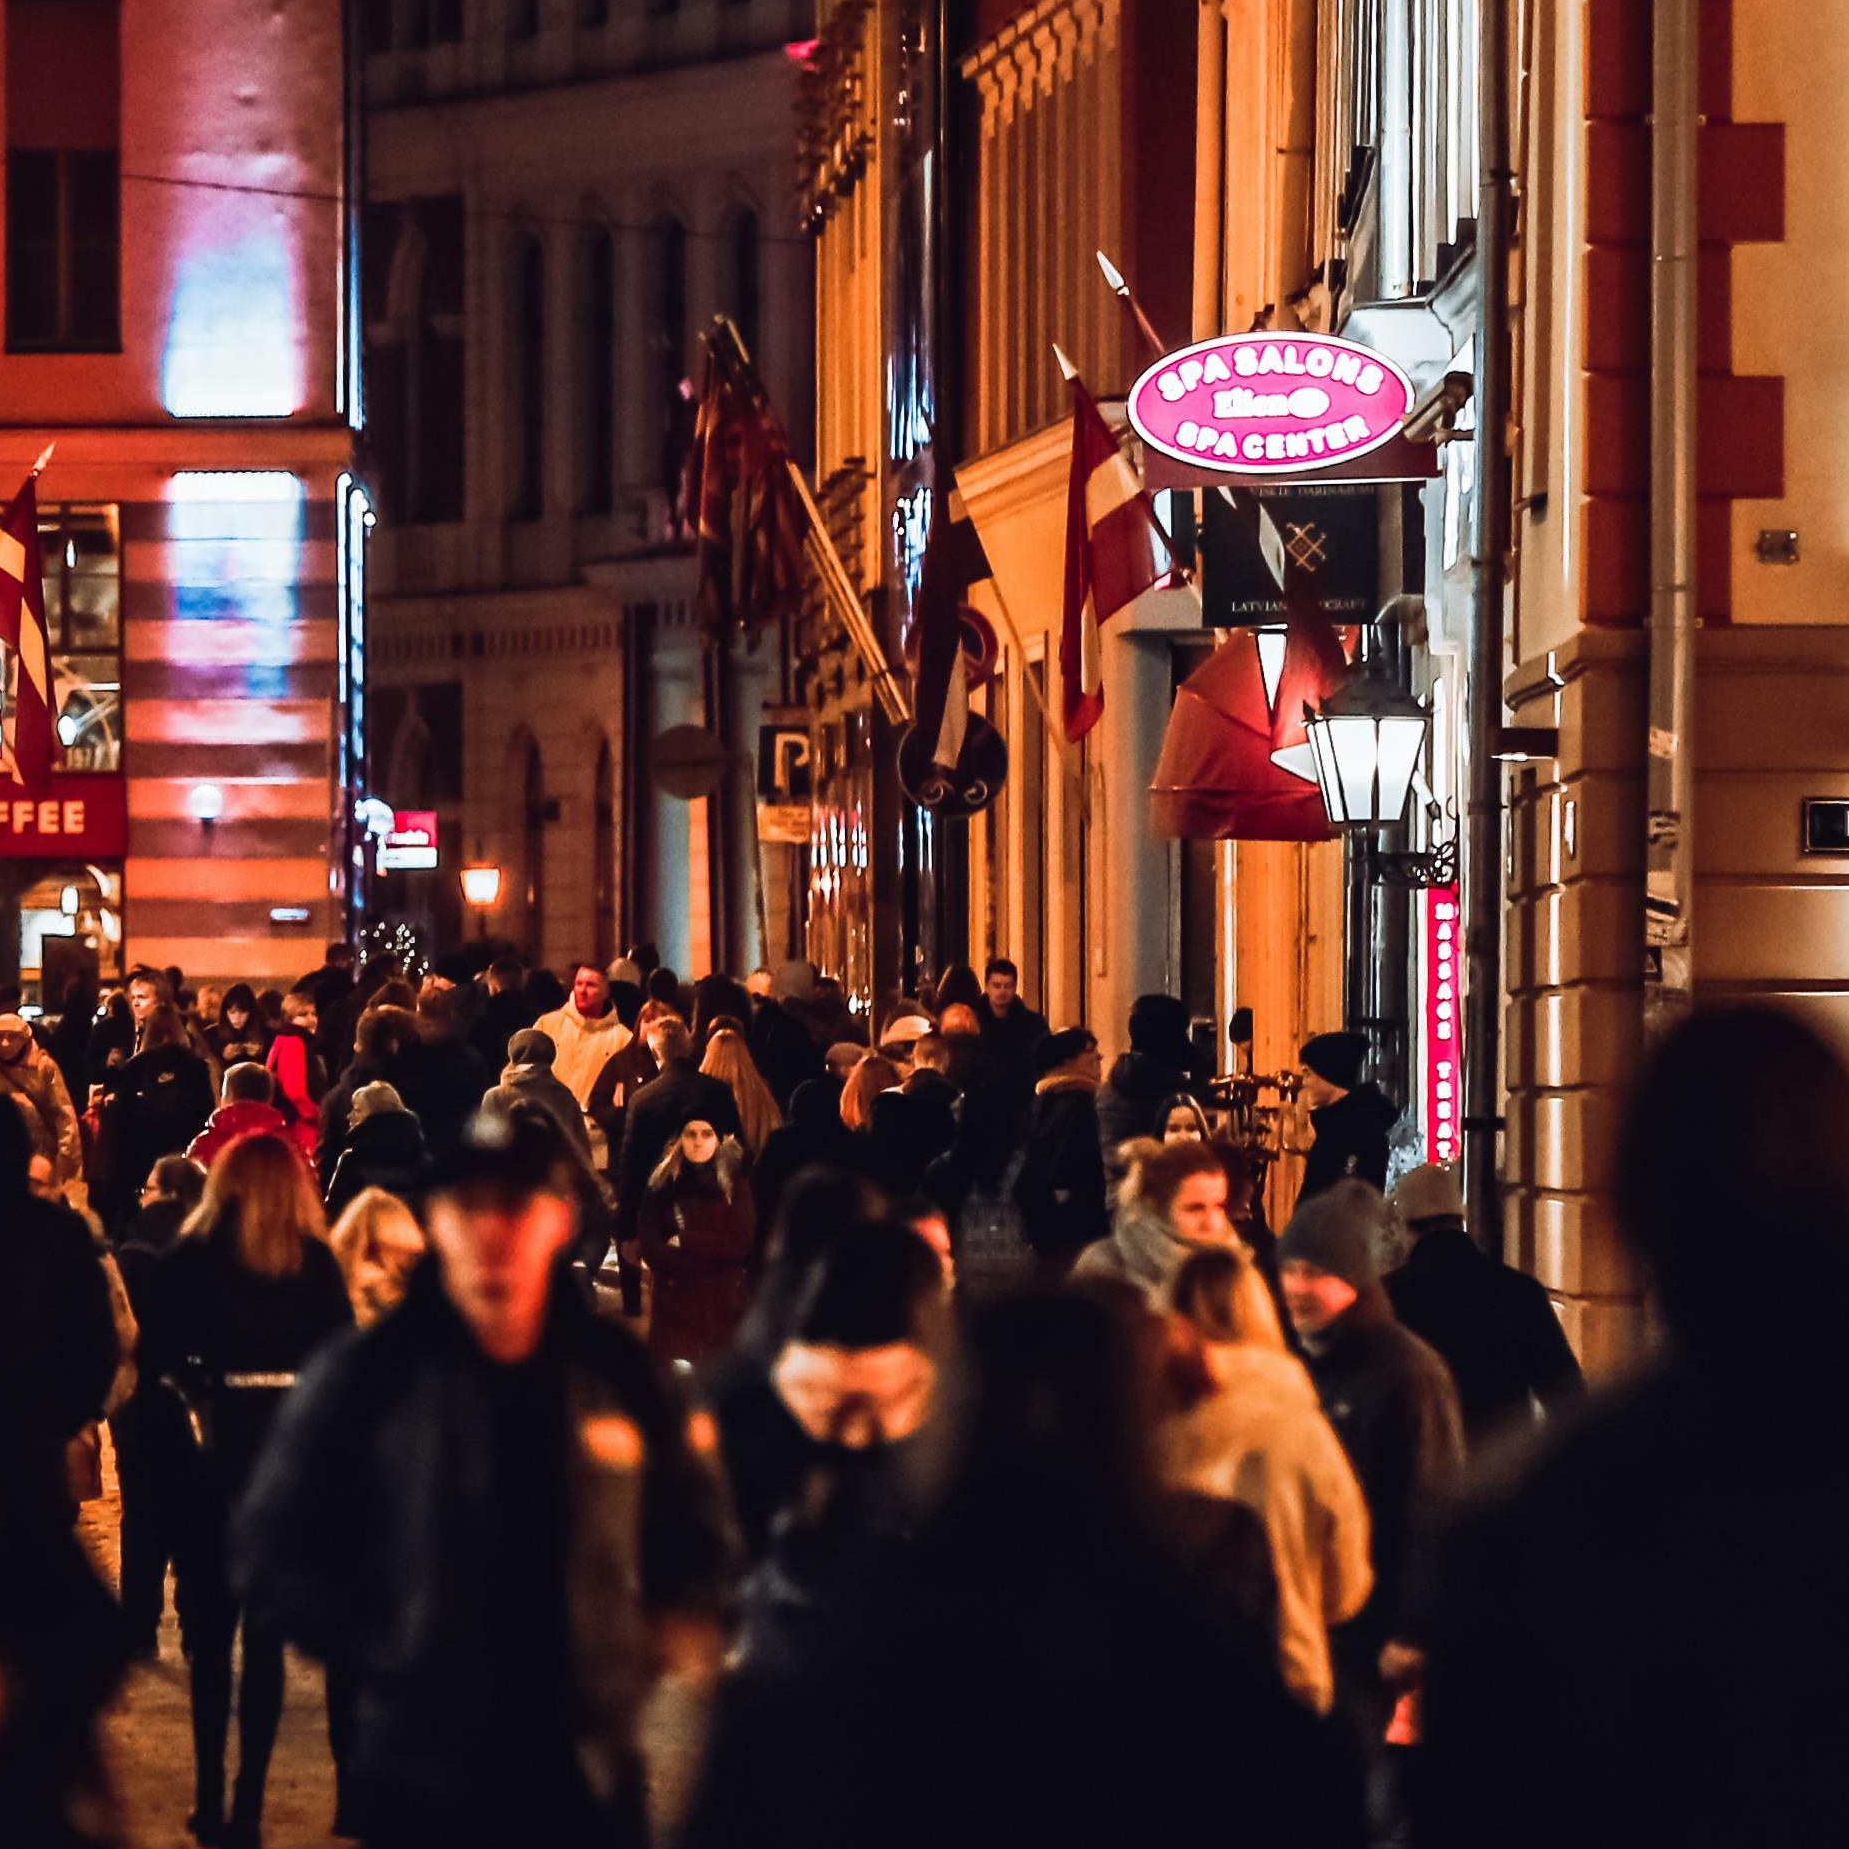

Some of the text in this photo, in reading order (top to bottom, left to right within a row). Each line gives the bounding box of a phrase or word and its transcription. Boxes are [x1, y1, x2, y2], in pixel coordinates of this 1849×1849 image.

[1157, 345, 1383, 400] SPA SALONS
[1176, 415, 1369, 459] SPA CENTER
[1435, 902, 1453, 1163] MASSAGE TREAT
